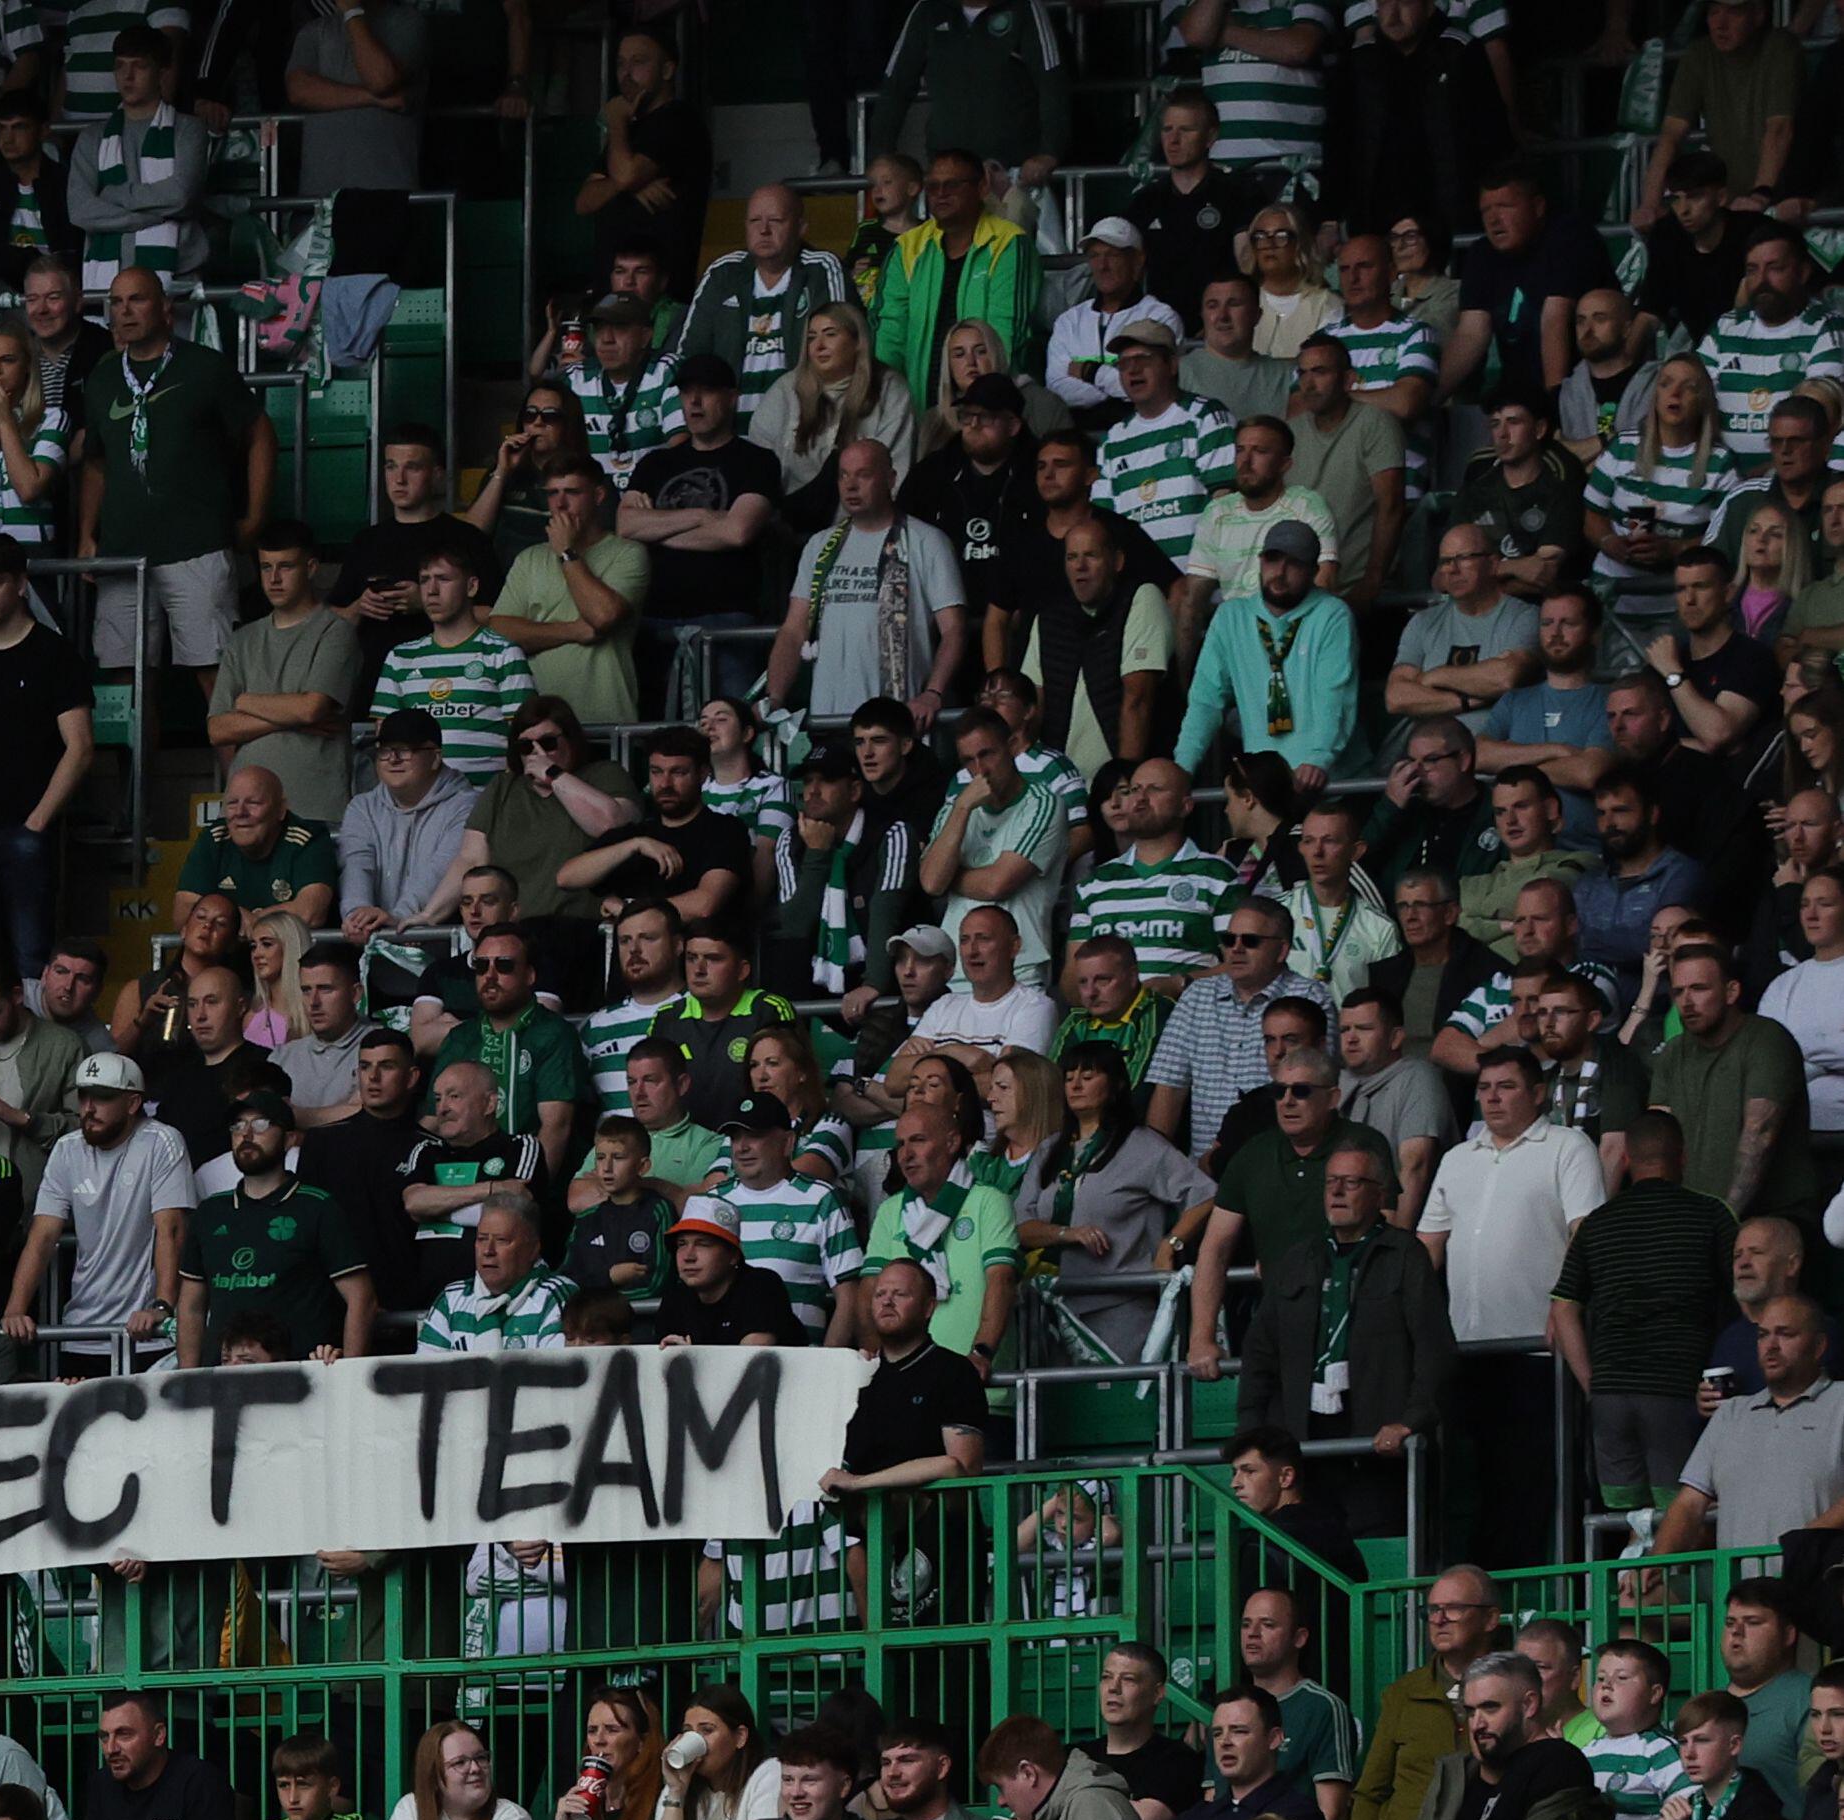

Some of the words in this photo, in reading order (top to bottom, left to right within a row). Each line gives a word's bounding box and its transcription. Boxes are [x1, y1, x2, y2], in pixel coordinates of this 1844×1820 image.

[1728, 413, 1769, 432] dafa
[827, 579, 850, 590] LIKE
[429, 701, 476, 718] fabet
[119, 899, 156, 919] KK
[1115, 919, 1185, 940] SMITH
[211, 1272, 277, 1291] dafabet
[370, 1349, 783, 1533] TEAM
